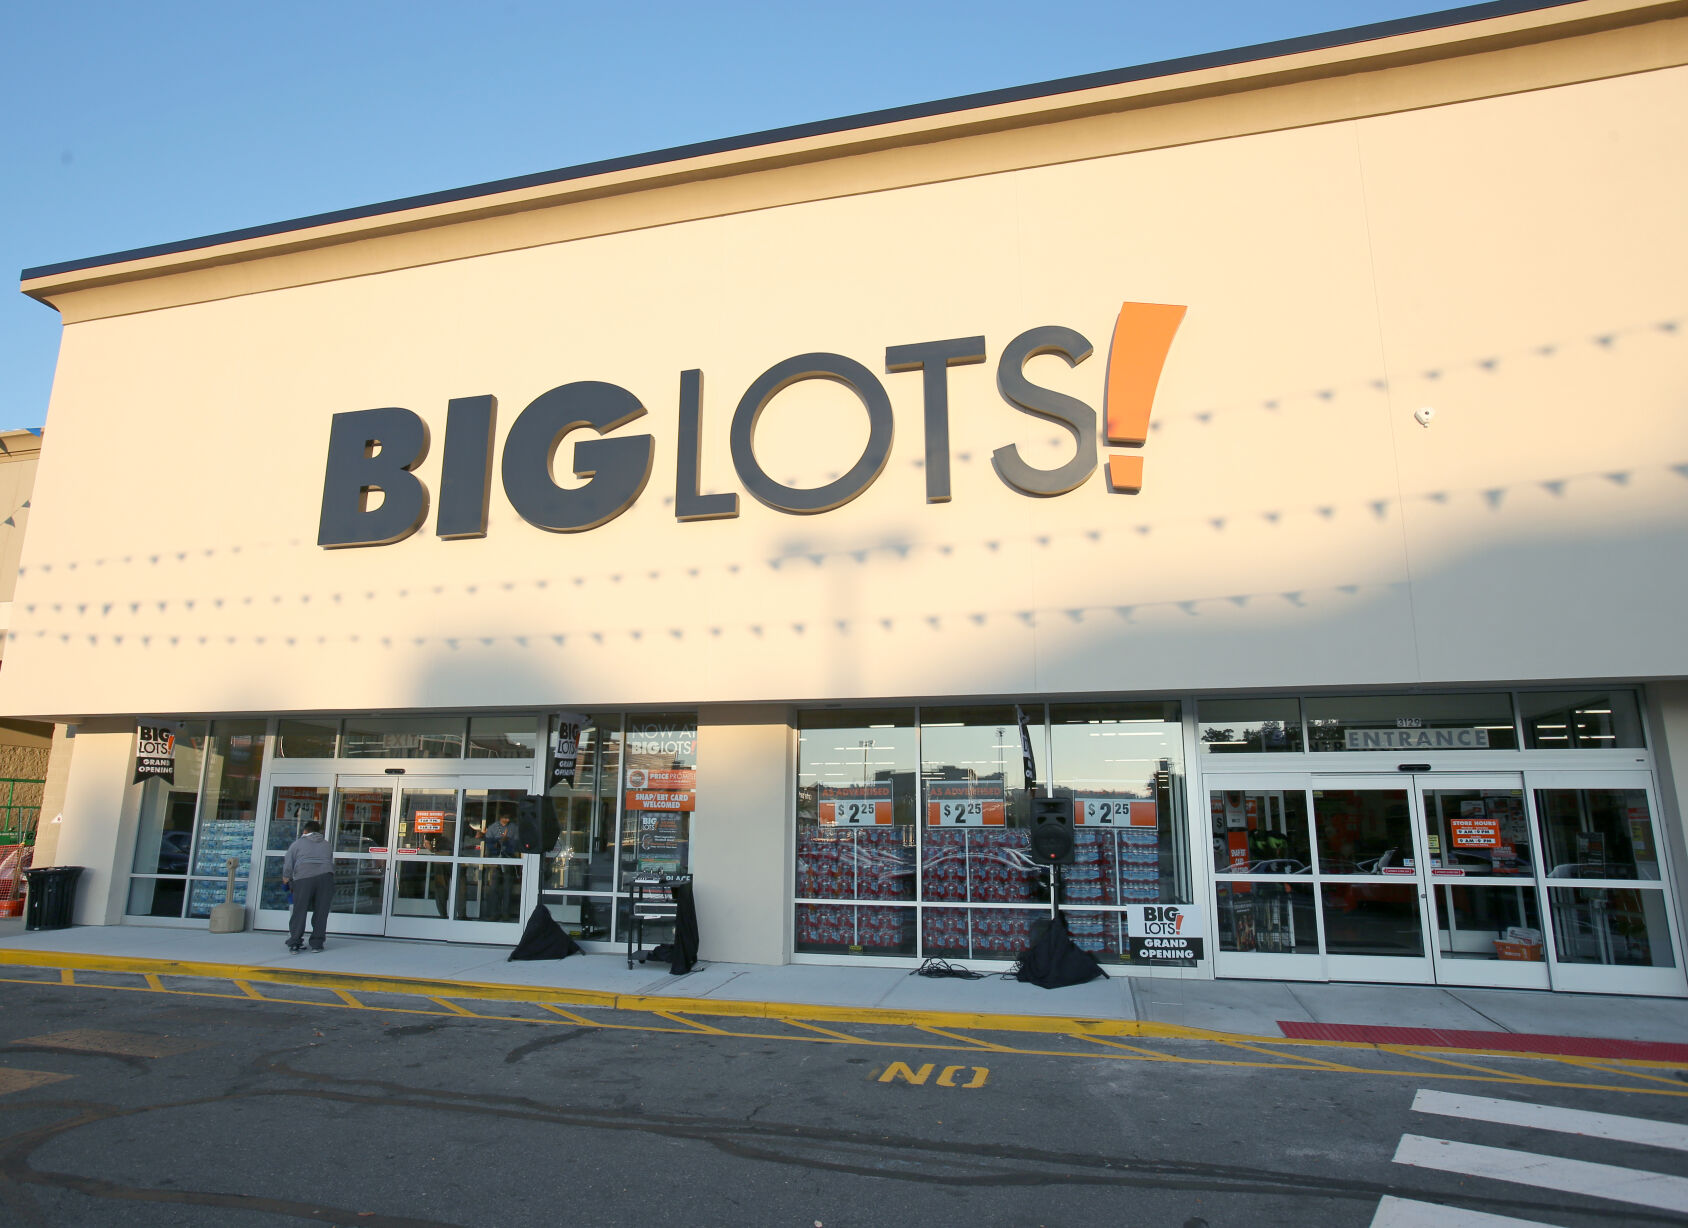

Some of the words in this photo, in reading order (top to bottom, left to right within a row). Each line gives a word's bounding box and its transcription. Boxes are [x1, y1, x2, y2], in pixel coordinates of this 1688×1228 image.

[140, 726, 170, 742] BIG
[632, 724, 674, 739] NOW
[1347, 730, 1486, 747] ENTRANCE
[139, 735, 175, 755] LOTS!
[670, 794, 688, 802] CARD
[823, 788, 834, 796] AS
[836, 787, 889, 796] ADVERTISED
[643, 801, 680, 809] WELCOMED
[1143, 906, 1180, 922] BIG
[1144, 914, 1184, 935] LOTS!
[1144, 938, 1187, 948] GRAND
[1139, 949, 1194, 959] OPENING
[878, 1061, 990, 1089] NO
